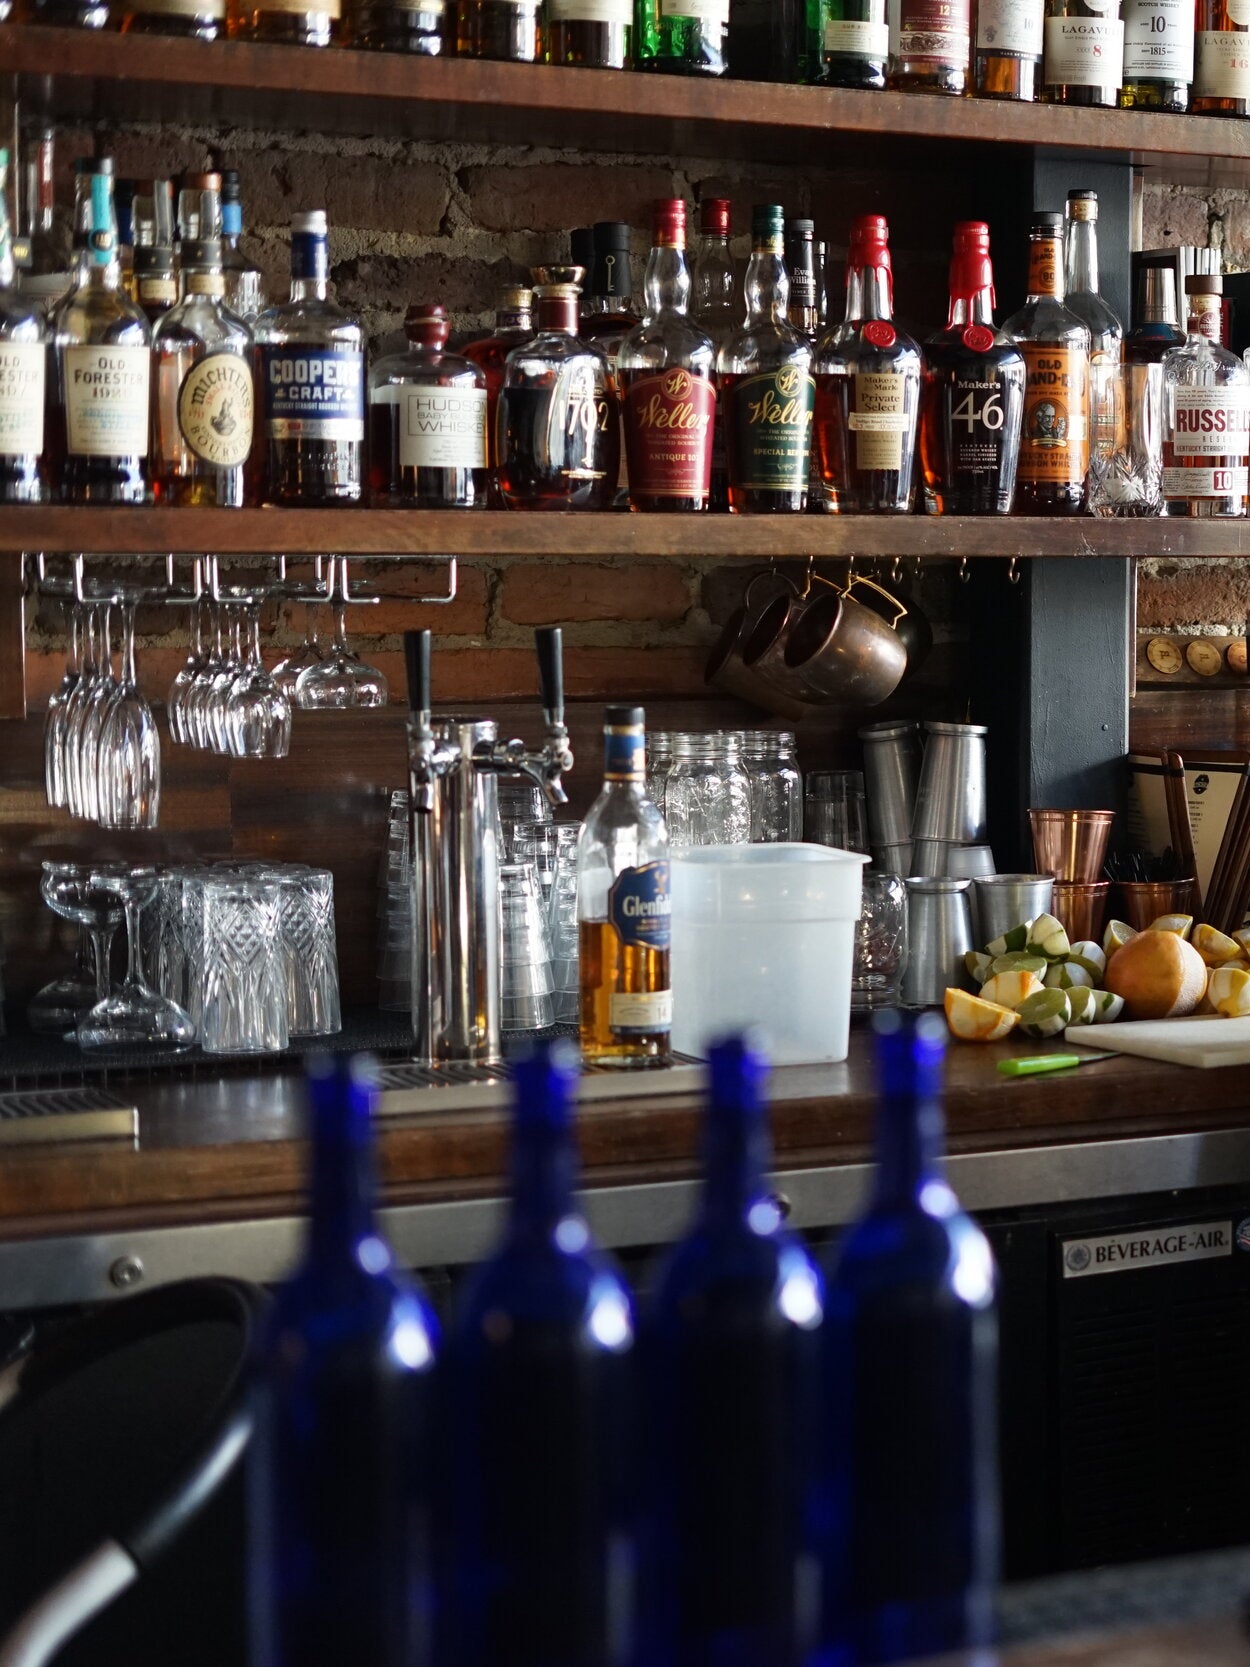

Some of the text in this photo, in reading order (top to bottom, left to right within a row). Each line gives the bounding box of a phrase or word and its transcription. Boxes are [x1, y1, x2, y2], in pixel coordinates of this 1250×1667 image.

[1150, 16, 1166, 32] 10
[1092, 44, 1102, 58] 8
[1229, 58, 1248, 69] 16
[97, 356, 126, 370] OLD
[1037, 358, 1063, 371] OLD
[73, 368, 144, 385] FORESTER
[958, 381, 1001, 389] Maker's
[289, 386, 344, 400] CRAFT
[861, 393, 900, 402] Private
[637, 394, 710, 432] Weller
[865, 402, 896, 412] Select
[952, 391, 1004, 434] 46
[649, 453, 687, 462] ANTIQUE
[1216, 472, 1230, 489] 10
